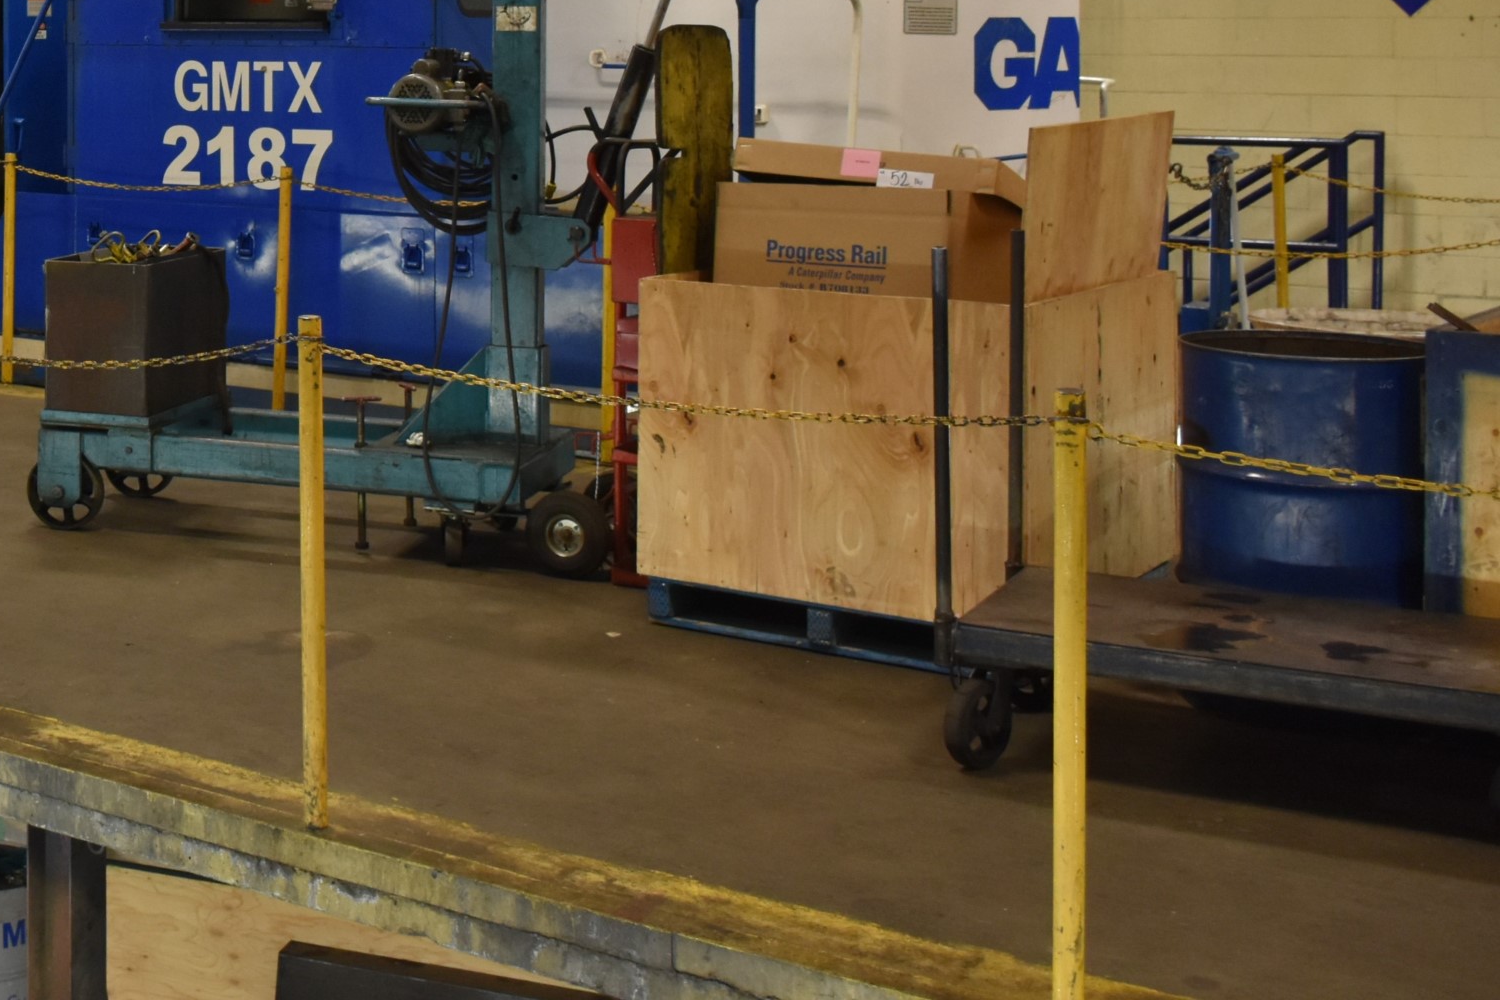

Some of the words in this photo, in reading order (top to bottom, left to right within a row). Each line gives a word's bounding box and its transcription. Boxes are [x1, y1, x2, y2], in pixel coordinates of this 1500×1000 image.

[173, 59, 323, 114] GMTX
[162, 124, 334, 191] 2187
[890, 171, 910, 187] 52
[766, 239, 846, 264] Progress
[851, 245, 888, 265] Rail
[788, 266, 795, 277] A
[796, 267, 843, 281] Caterpillar
[845, 270, 886, 285] Company
